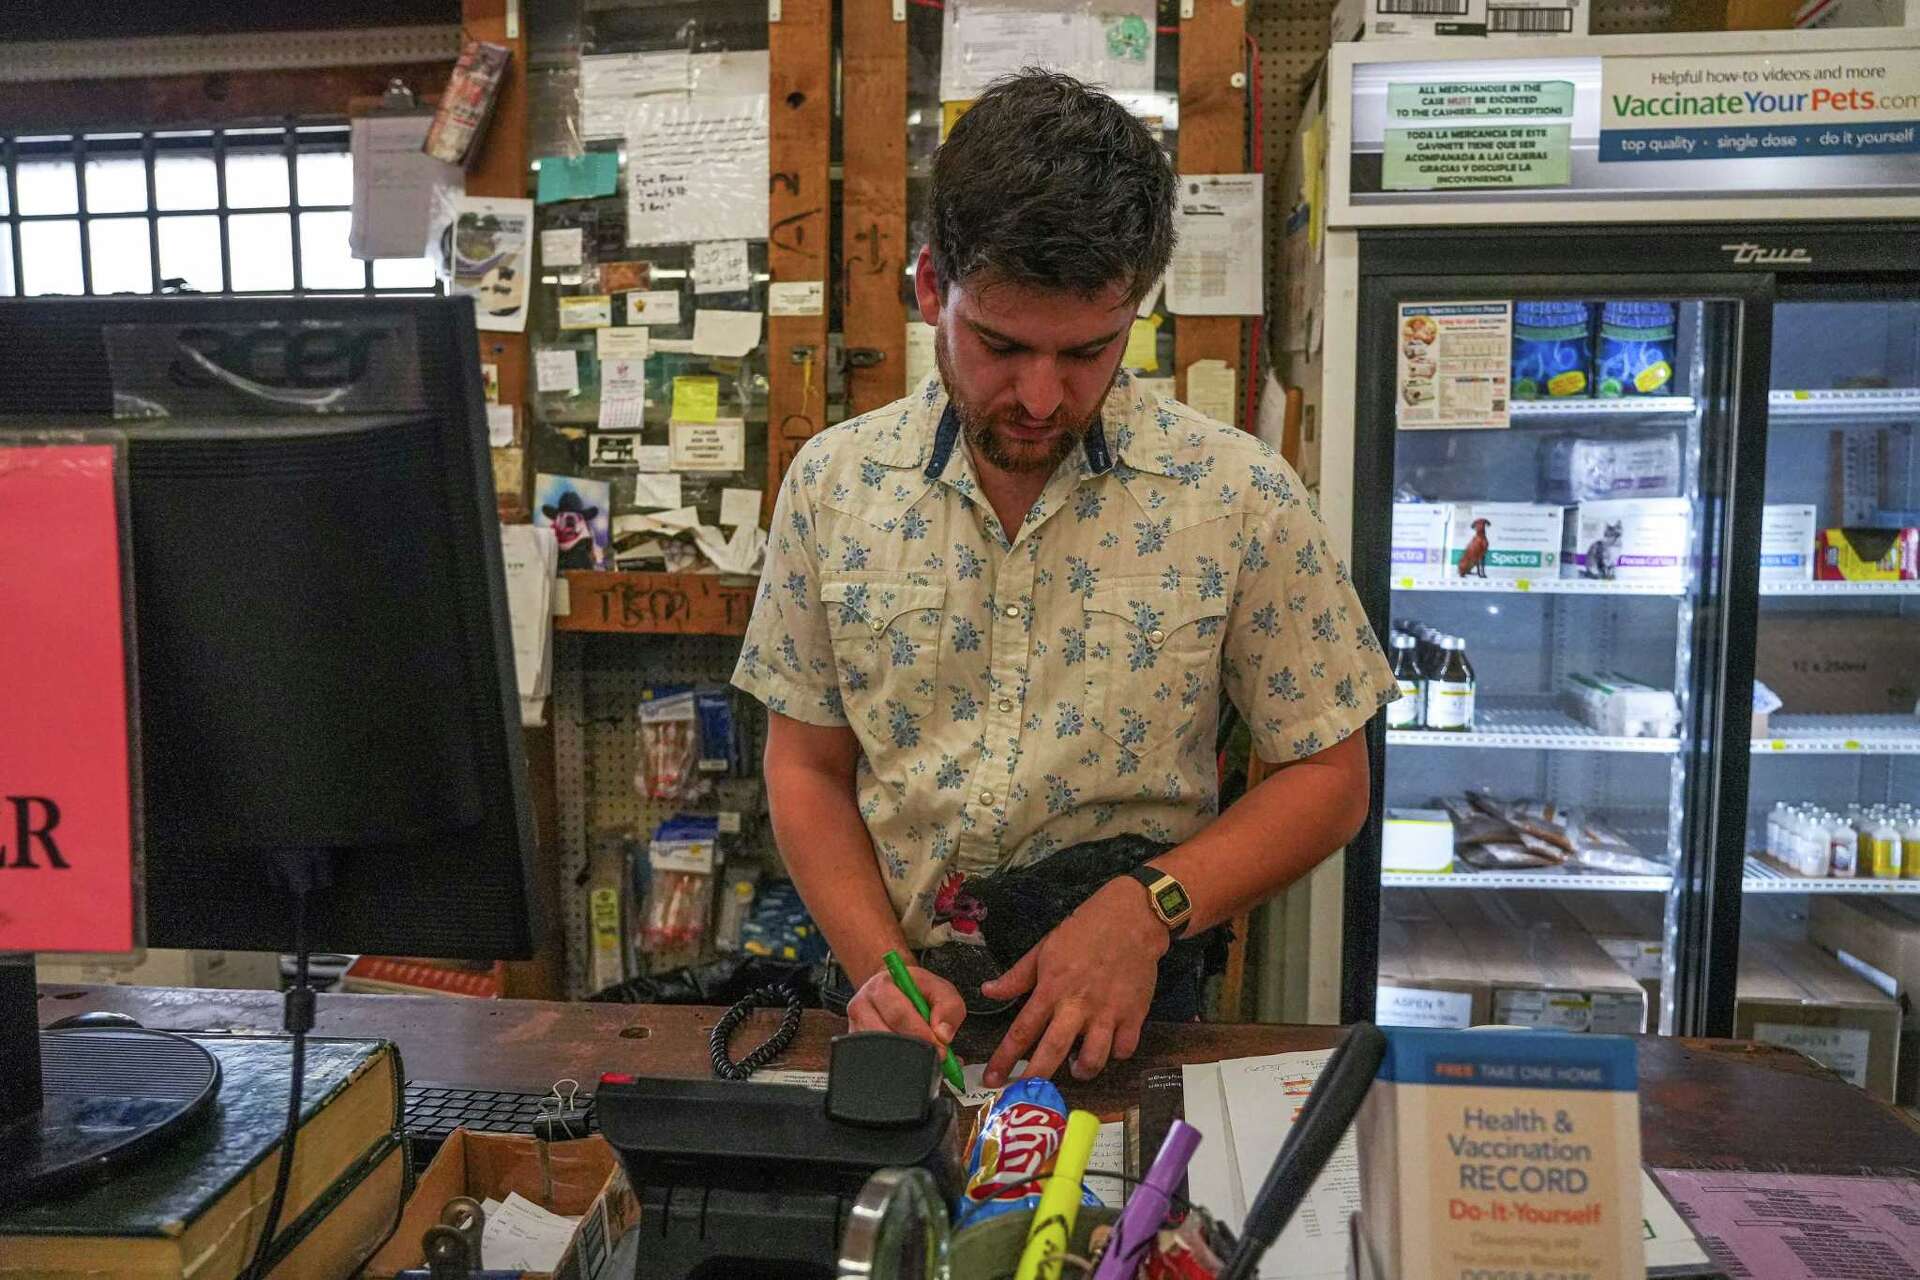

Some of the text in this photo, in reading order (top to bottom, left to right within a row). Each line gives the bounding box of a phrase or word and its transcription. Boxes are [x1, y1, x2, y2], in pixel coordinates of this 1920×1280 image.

[1651, 65, 1886, 86] Helpful how-to videos and more
[1418, 84, 1541, 94] ALL MERCHANDISE IN THE
[1421, 97, 1444, 105] CASE
[1474, 96, 1486, 104] BE
[1489, 95, 1538, 104] ESCORTED
[1396, 109, 1409, 117] TO
[1412, 108, 1429, 117] THE
[1505, 106, 1563, 115] EXCEPTIONS
[1406, 131, 1433, 139] TODA
[1436, 131, 1448, 139] LA
[1510, 129, 1523, 138] DE
[1525, 129, 1547, 138] ESTE
[1621, 128, 1914, 155] top quality single dose do it yourself
[1467, 141, 1494, 150] TIENE
[1496, 141, 1517, 150] QUE
[1477, 153, 1485, 161] A
[1487, 152, 1505, 161] LAS
[1419, 164, 1461, 173] GRACIAS
[1462, 164, 1469, 172] Y
[1519, 163, 1532, 171] LA
[1721, 243, 1812, 263] True
[1491, 551, 1538, 565] Spectra
[0, 796, 71, 870] R
[1481, 1065, 1515, 1080] TAKE
[1520, 1066, 1549, 1081] ONE
[1554, 1067, 1602, 1083] HOME
[1464, 1106, 1574, 1134] Health &
[1447, 1133, 1592, 1161] Vaccination
[1459, 1164, 1589, 1194] RECORD
